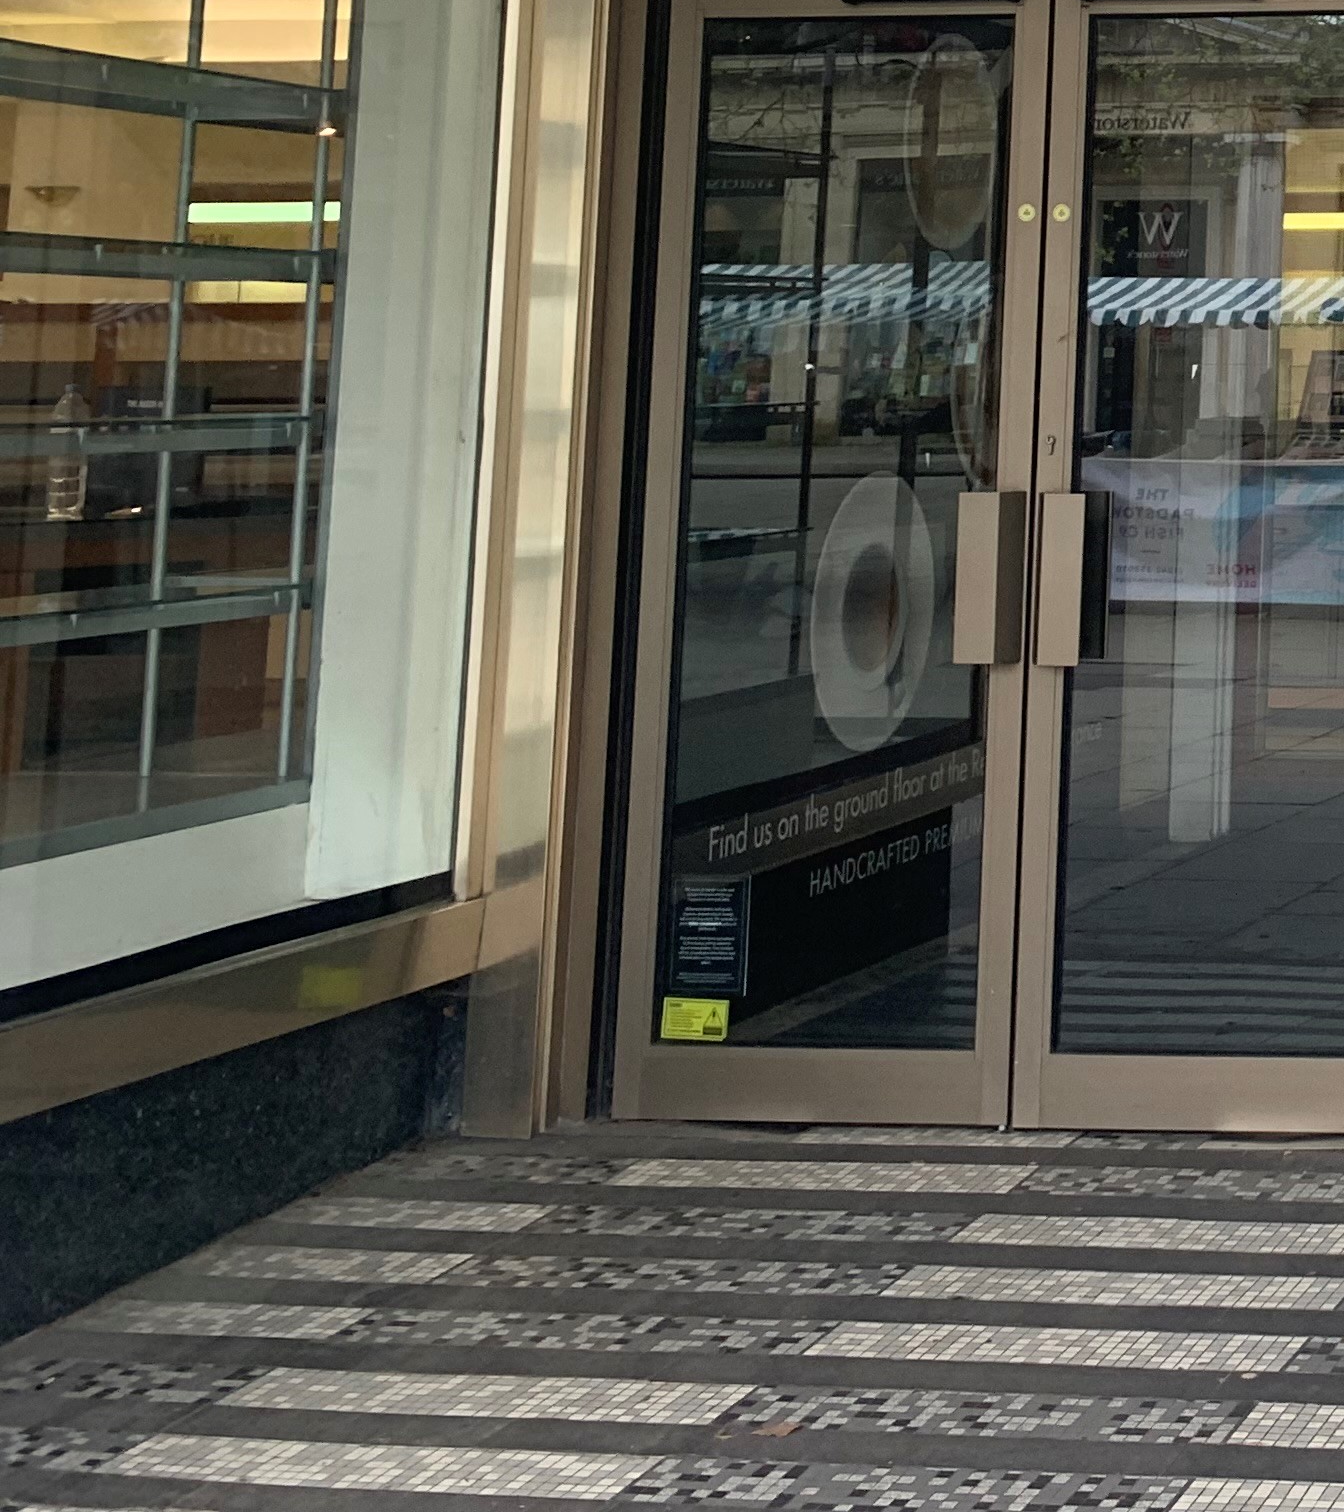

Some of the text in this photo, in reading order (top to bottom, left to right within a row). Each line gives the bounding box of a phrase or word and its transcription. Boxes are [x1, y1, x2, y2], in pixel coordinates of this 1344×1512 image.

[708, 813, 748, 862] Find
[754, 823, 772, 848] us
[778, 813, 799, 840] on
[805, 794, 829, 831] the
[834, 778, 889, 833] ground
[893, 767, 926, 806] floor
[930, 768, 944, 793] at
[949, 759, 967, 784] the
[809, 836, 919, 897] HANDCRAFTED
